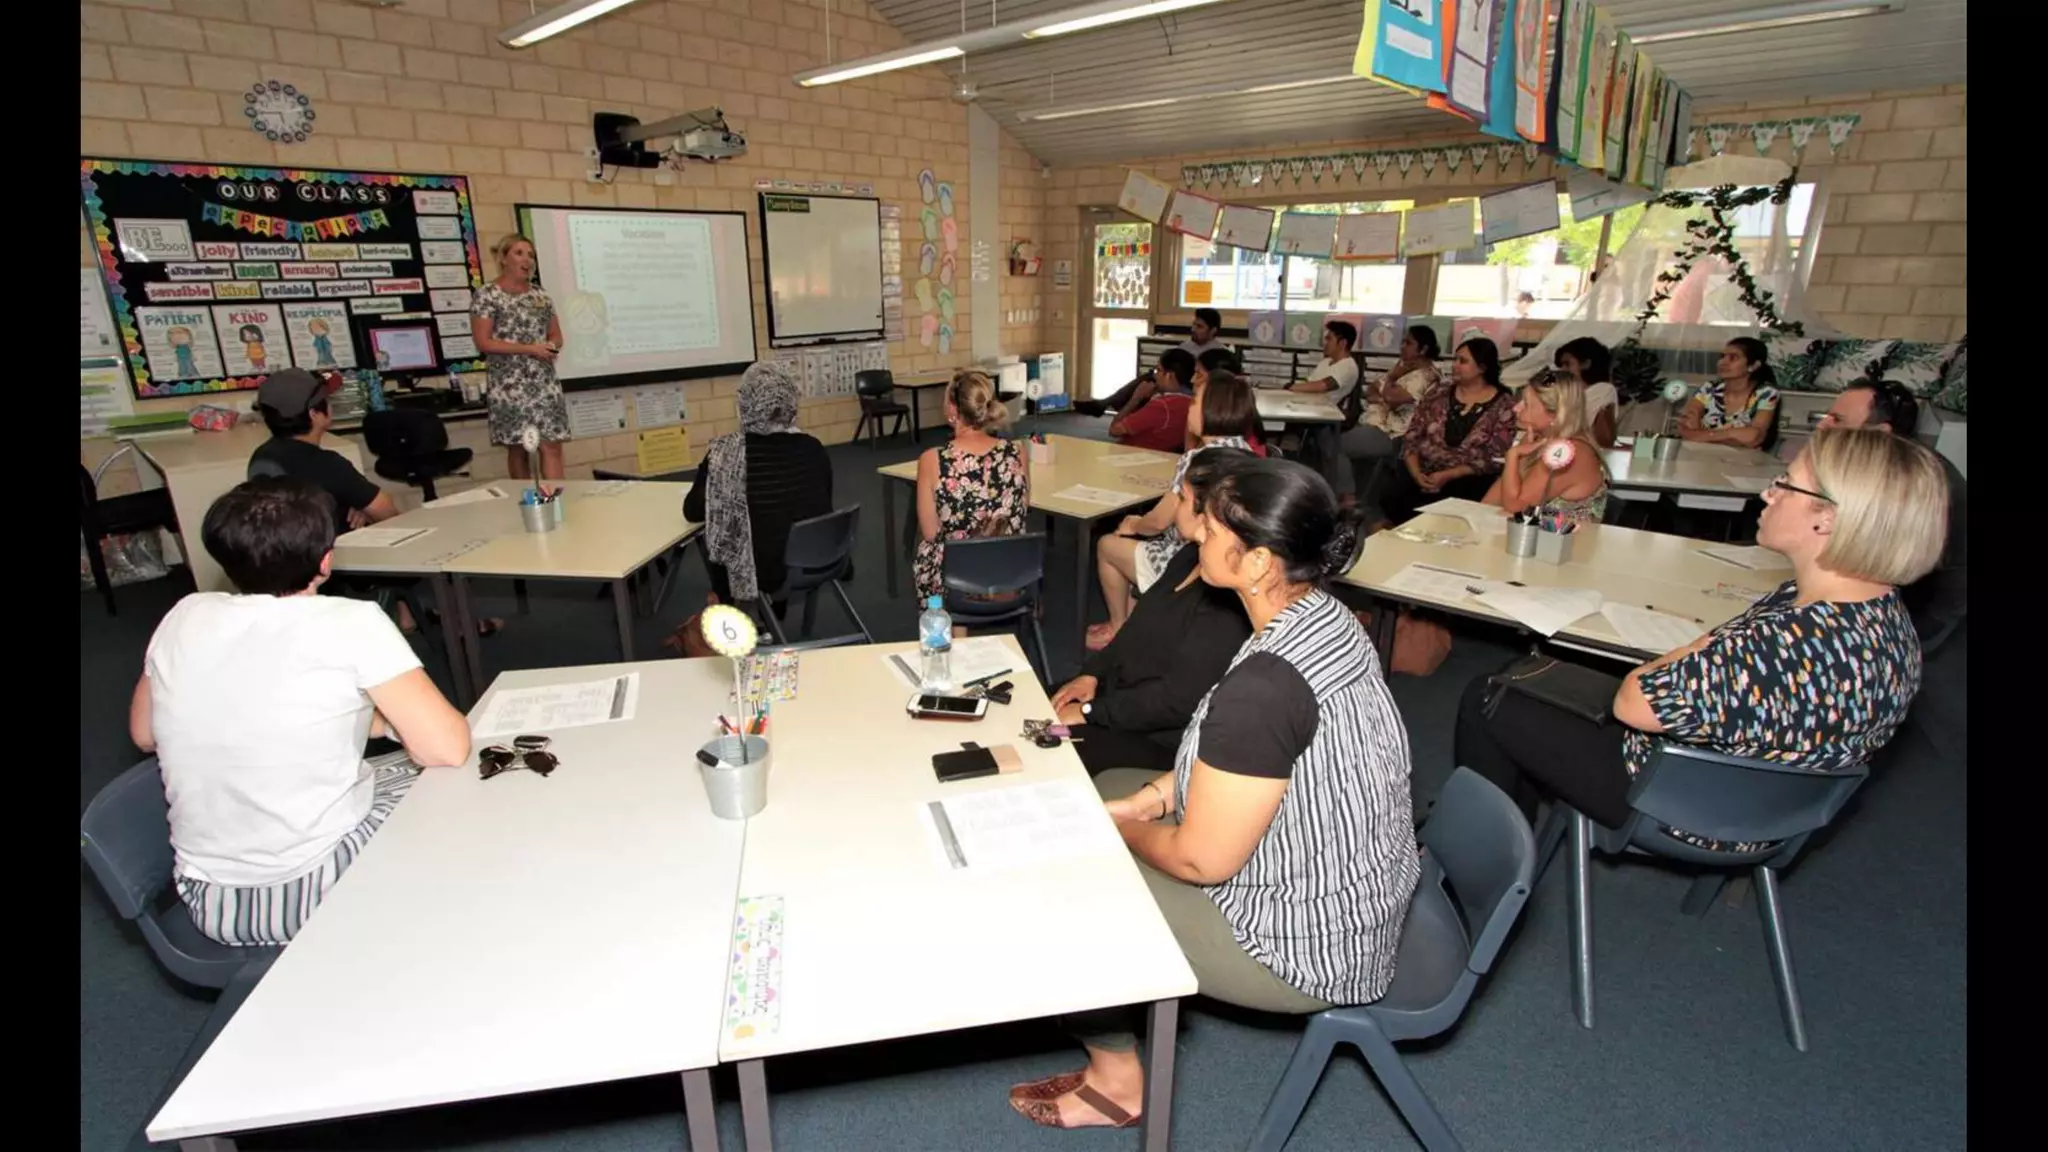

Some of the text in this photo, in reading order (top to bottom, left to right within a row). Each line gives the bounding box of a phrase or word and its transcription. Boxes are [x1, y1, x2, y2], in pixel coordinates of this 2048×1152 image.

[219, 184, 391, 203] OUR CLASS
[204, 204, 388, 239] expectations
[200, 244, 236, 258] jolly
[244, 244, 297, 258] friendly
[283, 264, 336, 278] amazing
[151, 285, 210, 297] sensible
[216, 284, 257, 296] kind
[319, 282, 367, 296] organised
[144, 313, 204, 326] PATIENT
[228, 312, 269, 325] KIND
[1553, 447, 1563, 458] 4
[722, 619, 737, 640] 6
